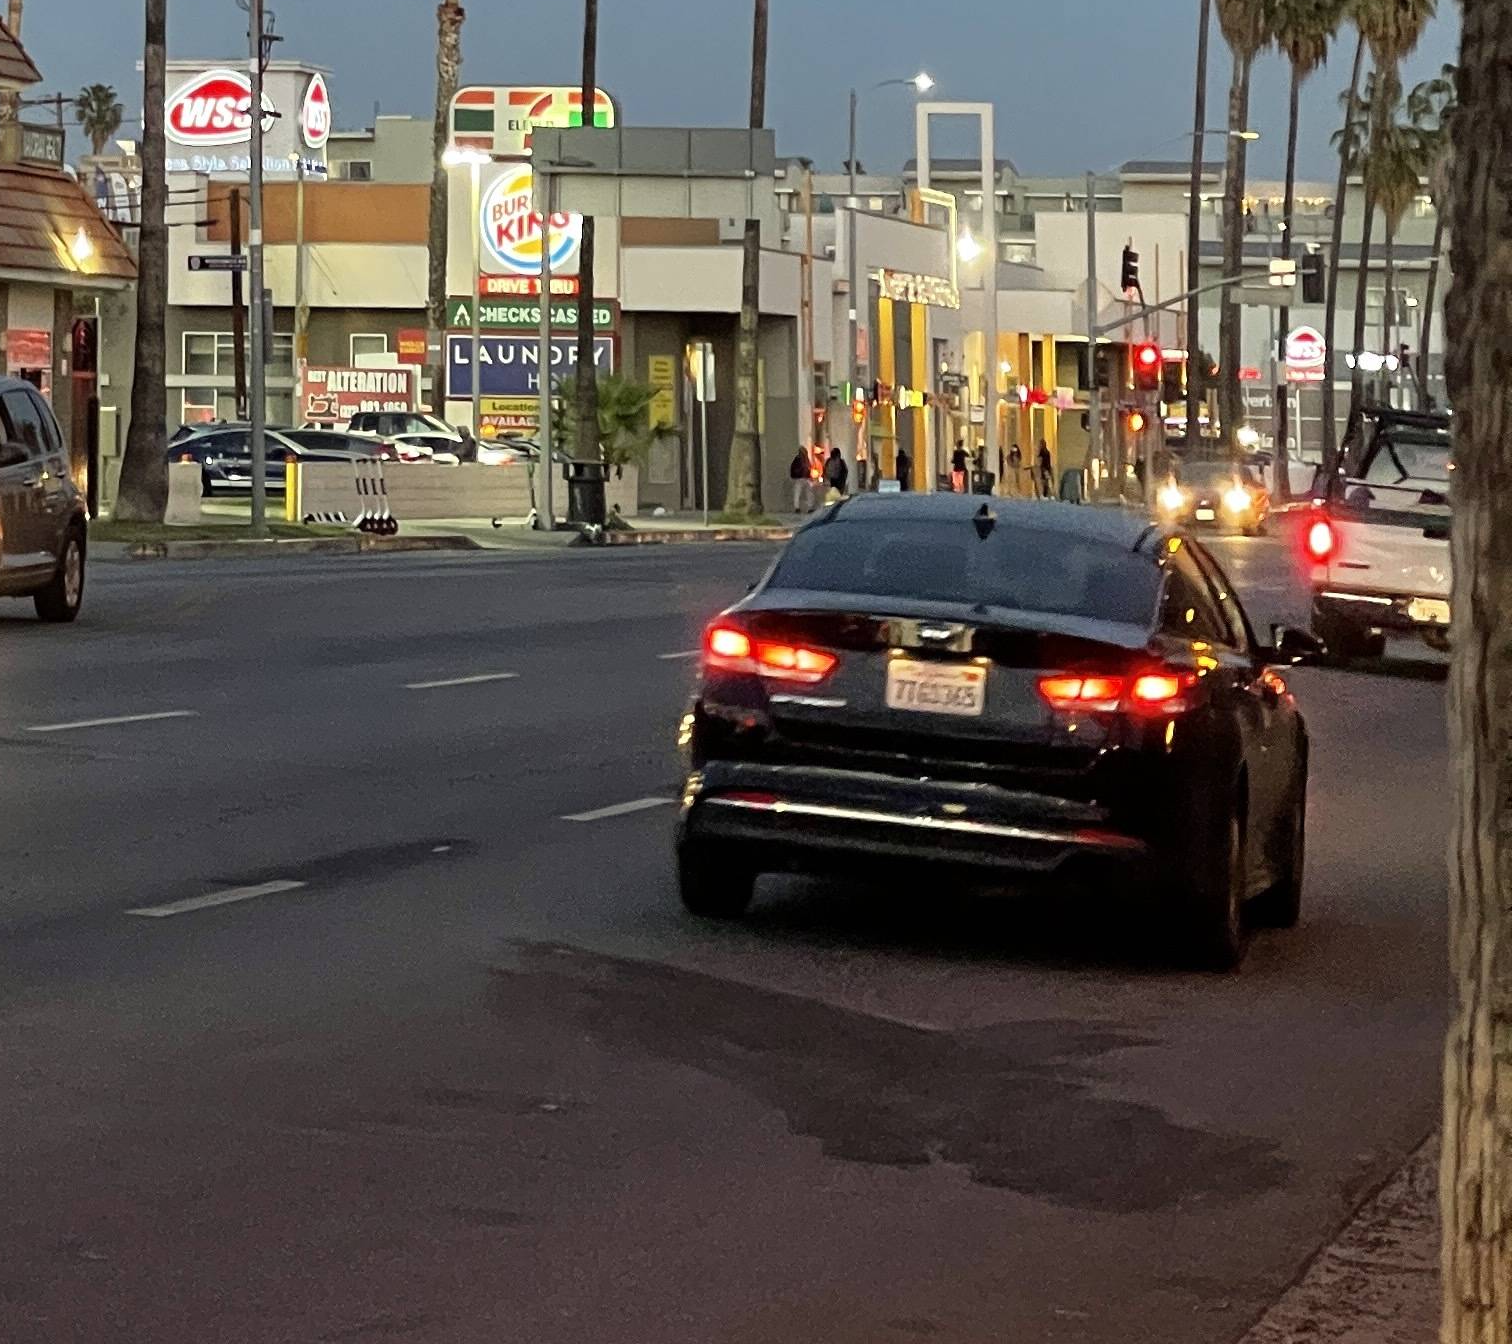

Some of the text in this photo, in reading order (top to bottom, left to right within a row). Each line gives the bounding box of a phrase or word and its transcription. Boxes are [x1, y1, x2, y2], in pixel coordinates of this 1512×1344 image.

[179, 96, 252, 129] WSS
[492, 195, 532, 223] BUR
[487, 278, 529, 294] DRIVE
[550, 308, 611, 324] CASED
[327, 370, 407, 393] ALTERATION
